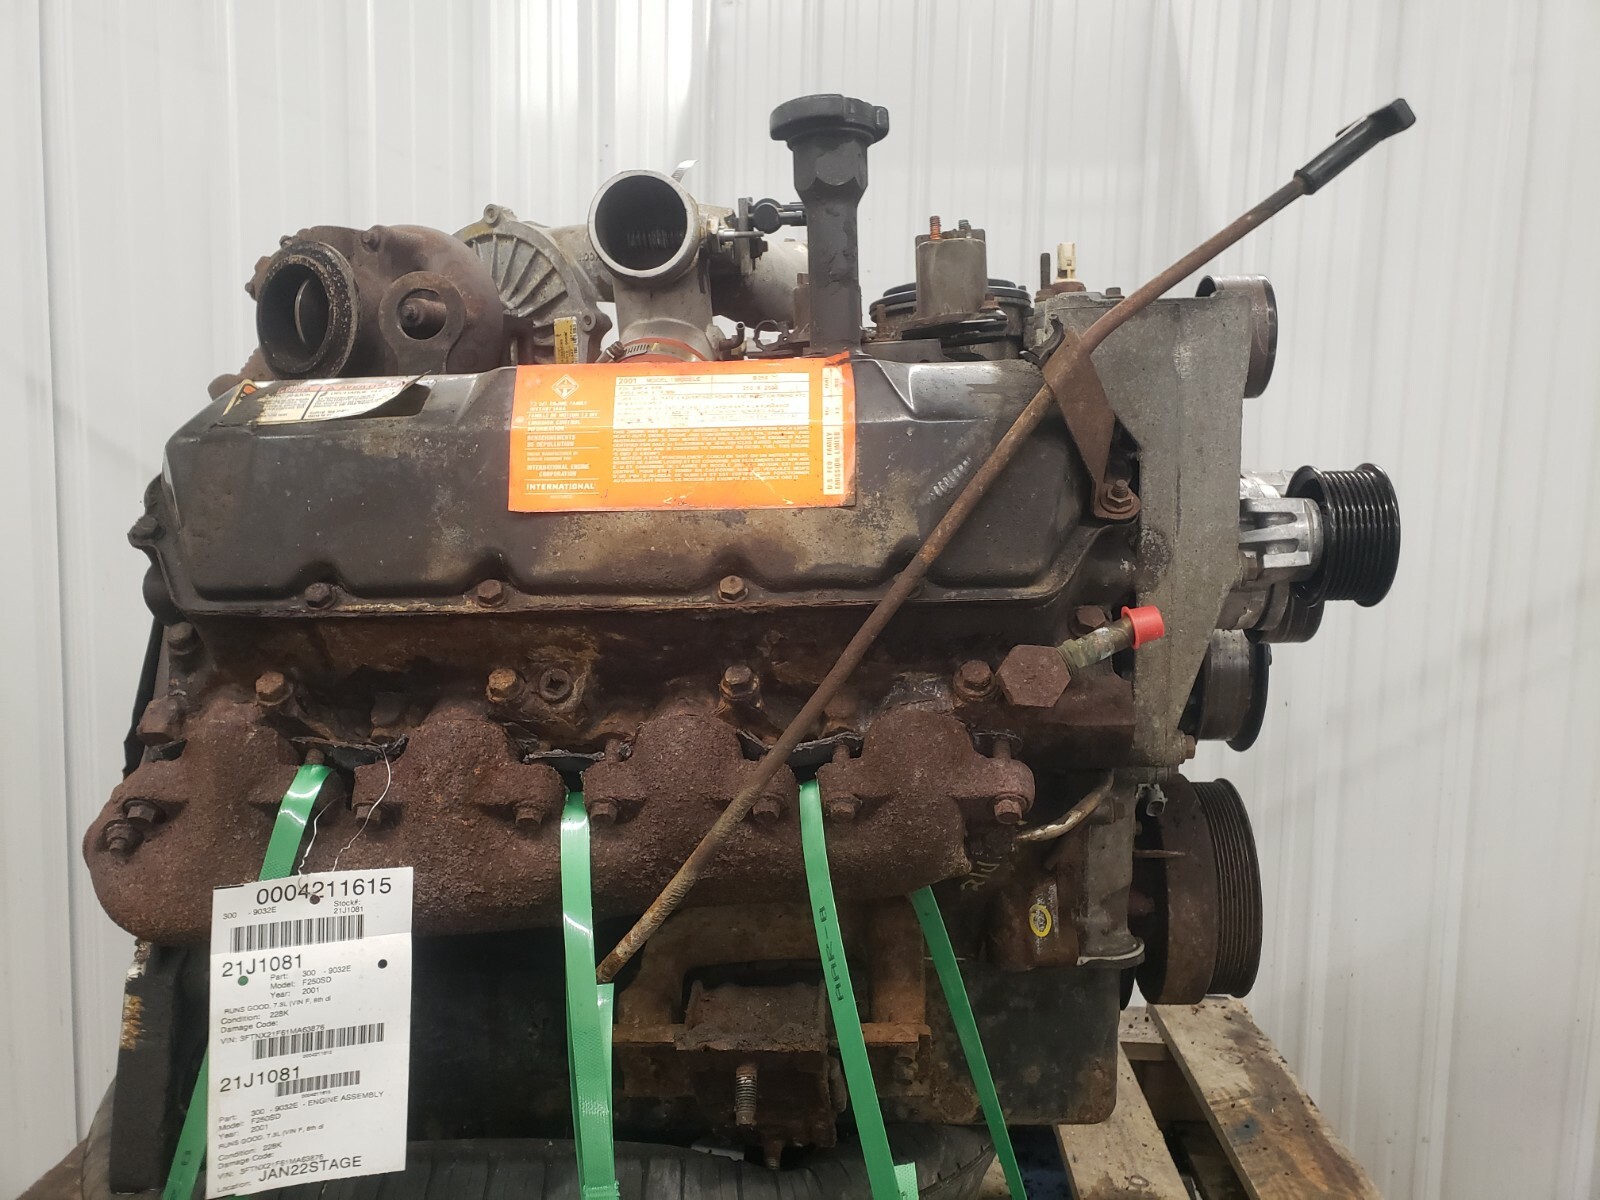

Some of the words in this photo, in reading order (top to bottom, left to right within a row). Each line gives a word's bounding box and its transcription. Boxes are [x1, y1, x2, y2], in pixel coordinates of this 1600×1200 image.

[825, 432, 833, 456] FAMILY
[256, 877, 392, 905] 0004211615
[334, 899, 361, 907] Stock#:
[334, 906, 364, 914] 21J1081
[222, 912, 238, 920] 300
[222, 954, 303, 977] 21J1081
[270, 973, 289, 981] Part:
[270, 981, 296, 990] Model:
[302, 976, 332, 986] F250SD
[270, 991, 291, 999] Year:
[302, 987, 320, 995] 2001
[220, 1023, 254, 1034] Damage
[255, 1020, 278, 1029] Code:
[220, 1066, 300, 1092] 21J1081
[307, 1095, 339, 1107] ENGINE
[340, 1090, 385, 1102] ASSEMBLY
[258, 1155, 363, 1182] JAN22STAGE
